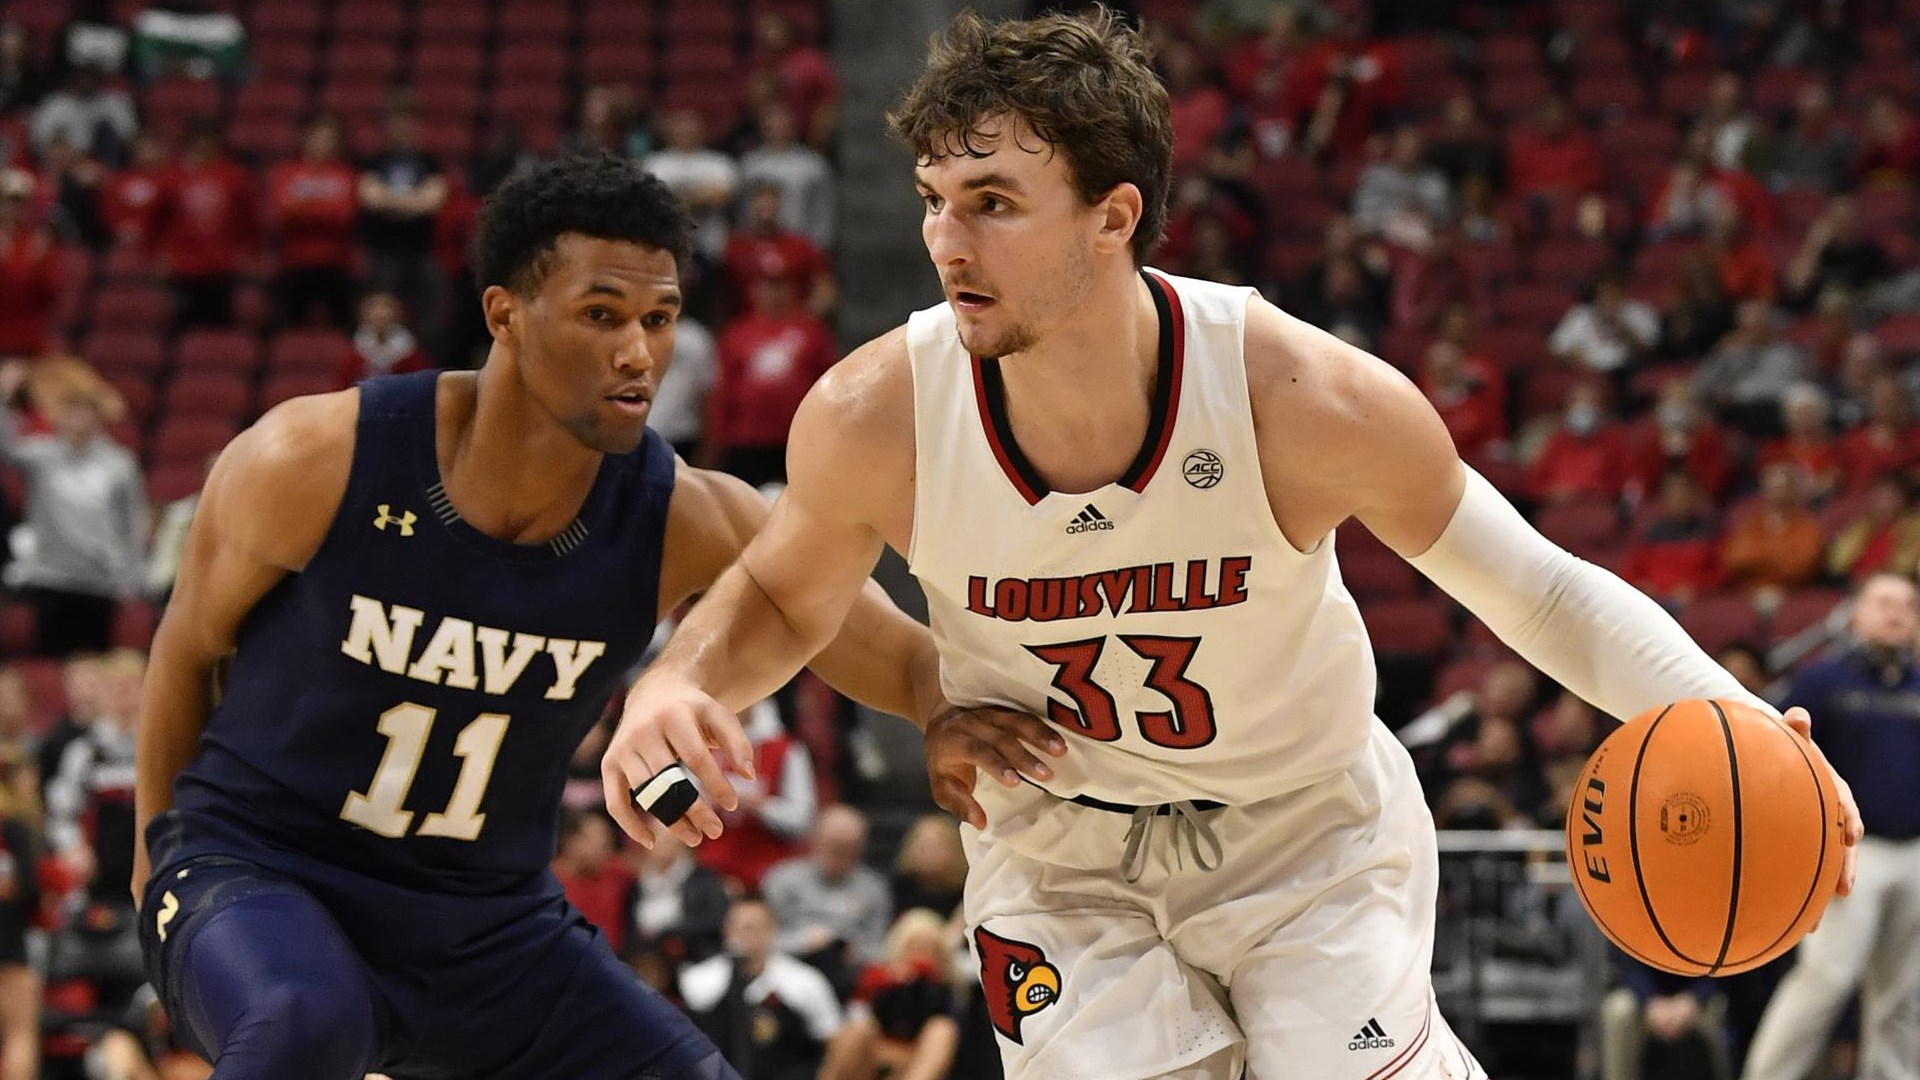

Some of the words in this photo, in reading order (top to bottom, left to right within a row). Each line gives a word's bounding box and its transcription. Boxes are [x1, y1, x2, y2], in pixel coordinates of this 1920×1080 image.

[1186, 462, 1220, 474] ACC
[1066, 519, 1114, 535] adidas
[965, 556, 1252, 622] LOUISVILLE
[341, 594, 606, 700] NAVY
[1020, 634, 1217, 750] 33
[339, 701, 511, 841] 11
[1583, 778, 1611, 884] EVO
[1348, 1037, 1395, 1051] adidas
